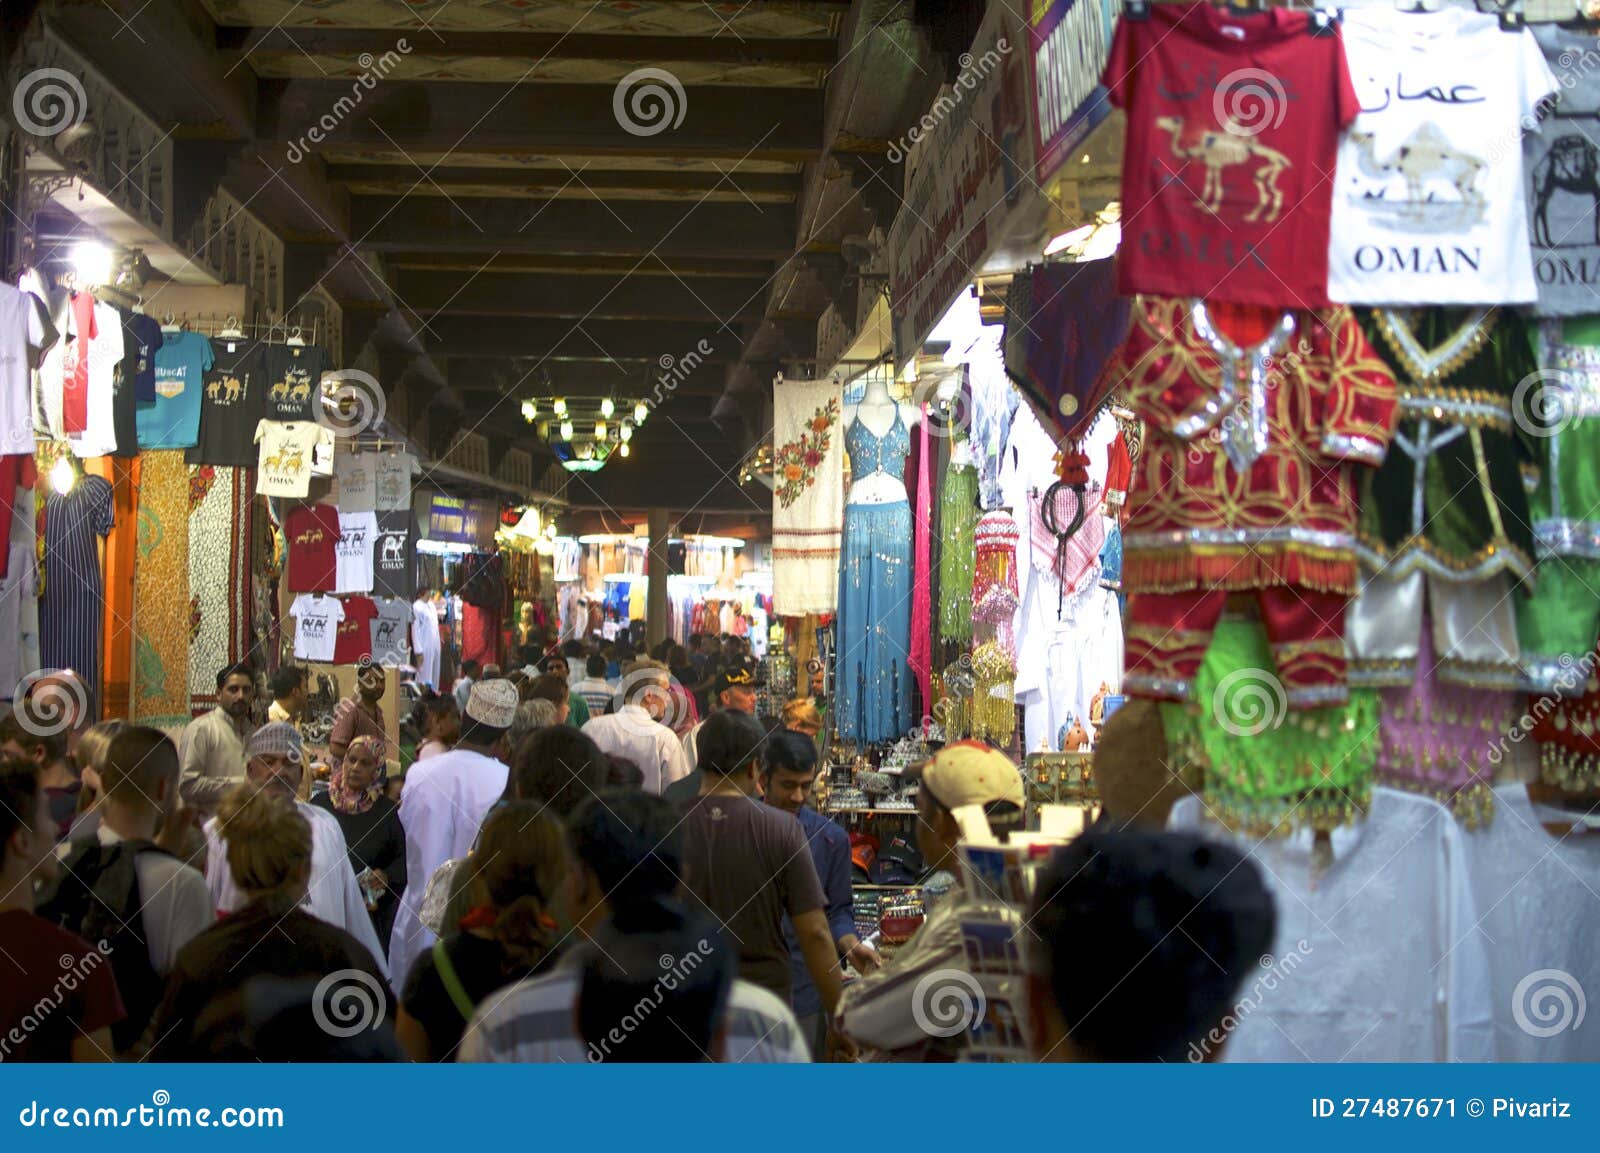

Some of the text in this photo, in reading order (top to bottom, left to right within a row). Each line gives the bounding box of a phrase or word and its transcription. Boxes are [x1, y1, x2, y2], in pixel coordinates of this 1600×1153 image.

[1358, 72, 1487, 113] عمان
[1354, 245, 1481, 274] OMAN
[277, 403, 302, 413] OMAN
[269, 476, 295, 486] OMAN
[339, 548, 363, 557] OMAN
[381, 561, 405, 570] OMAN
